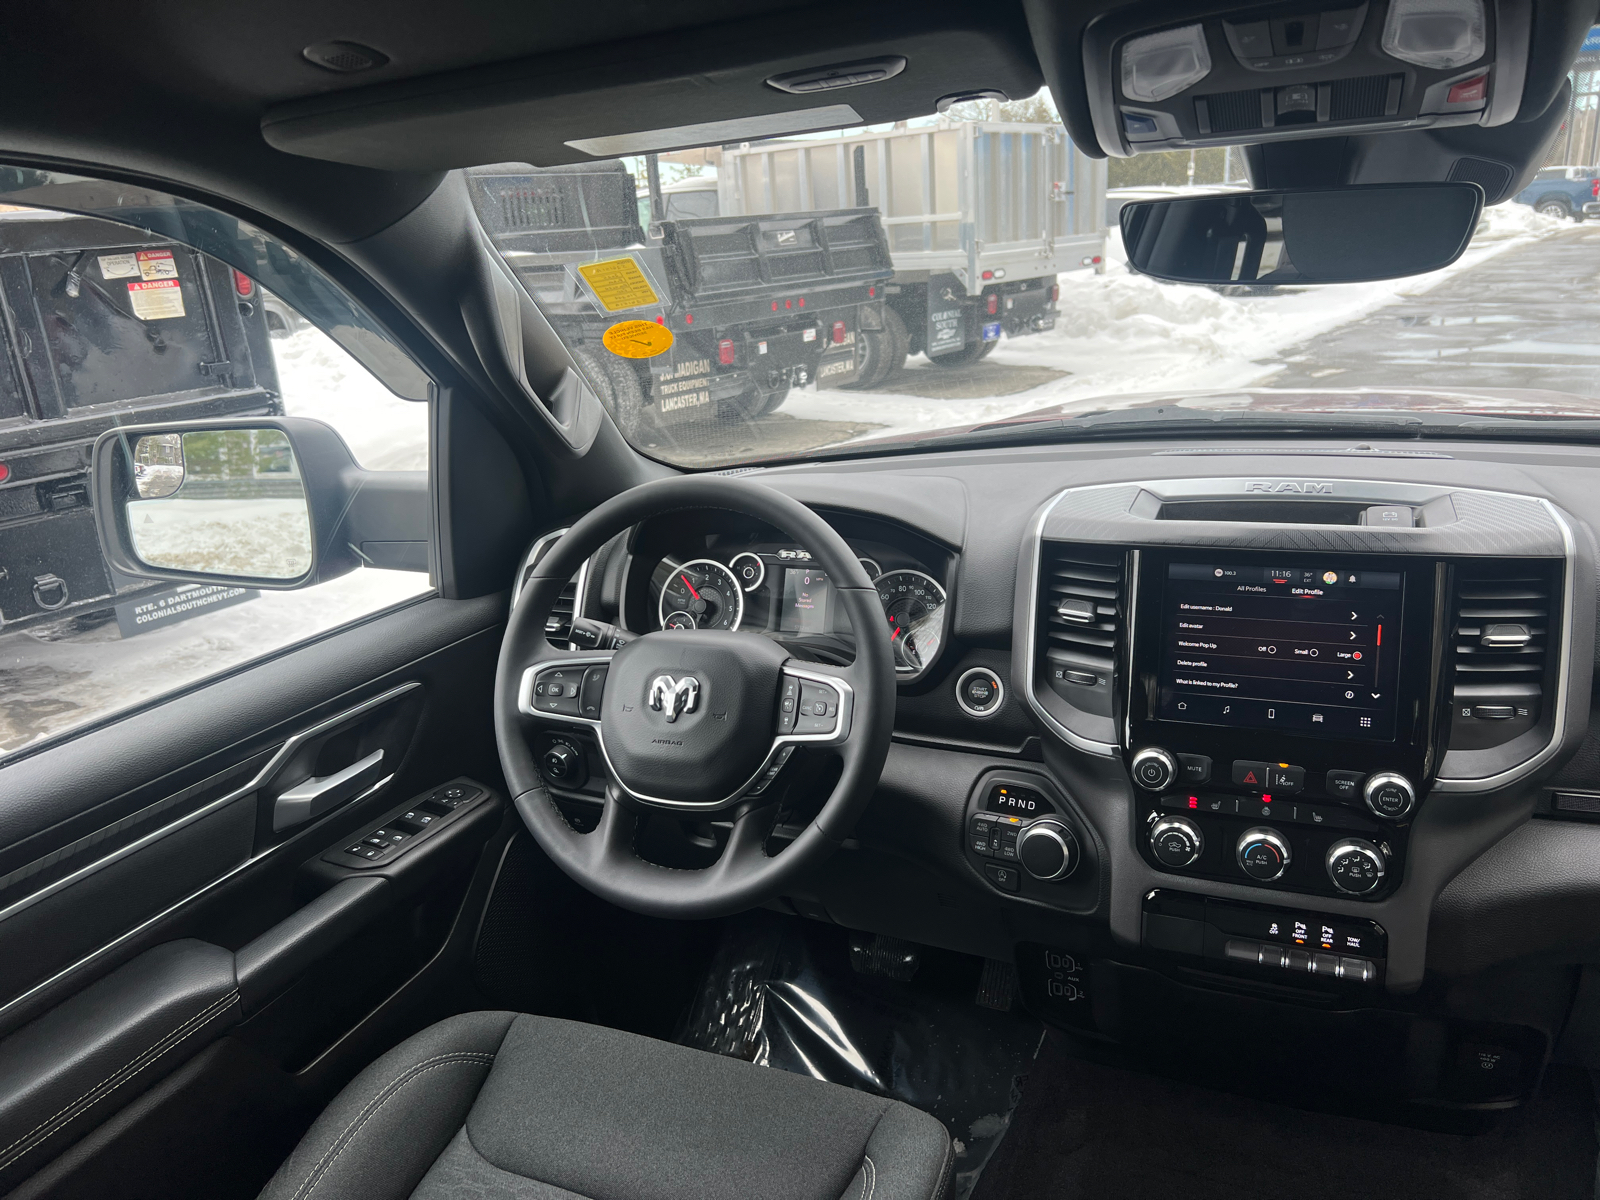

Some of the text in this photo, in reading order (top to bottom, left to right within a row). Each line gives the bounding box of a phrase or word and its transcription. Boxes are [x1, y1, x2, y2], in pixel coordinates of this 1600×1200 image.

[141, 280, 174, 289] DANGER
[1245, 481, 1333, 494] RAM
[780, 549, 813, 560] RA
[804, 577, 810, 585] 0
[1304, 588, 1324, 596] Profile
[134, 602, 158, 615] RTE.
[159, 599, 166, 607] 6
[136, 588, 246, 624] COLONIALSOUTHCHEVY.COM
[1337, 651, 1351, 659] Large
[1335, 779, 1355, 787] SCREEN
